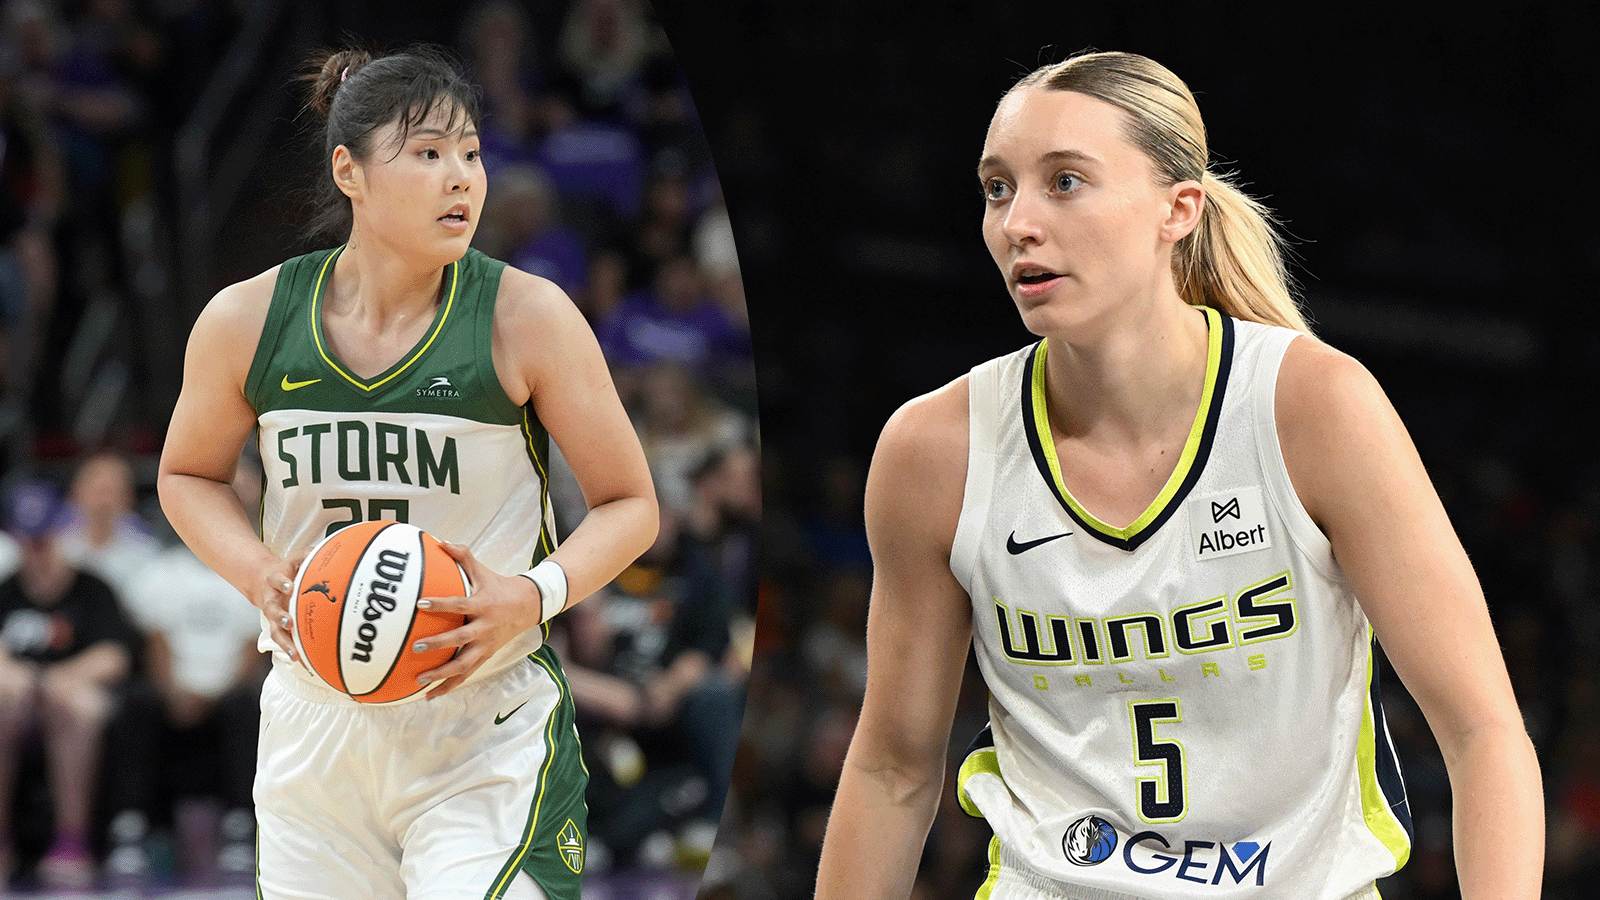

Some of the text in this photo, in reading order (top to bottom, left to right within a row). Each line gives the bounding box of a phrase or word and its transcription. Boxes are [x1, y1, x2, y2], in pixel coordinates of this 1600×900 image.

[416, 388, 460, 397] SYMETRA
[277, 420, 460, 495] STORM
[1199, 524, 1266, 555] Albert
[351, 549, 410, 663] Wilson
[994, 570, 1298, 665] WINGS
[1033, 653, 1267, 690] DALLAS
[1128, 698, 1188, 824] 5
[1123, 830, 1272, 886] GEM
